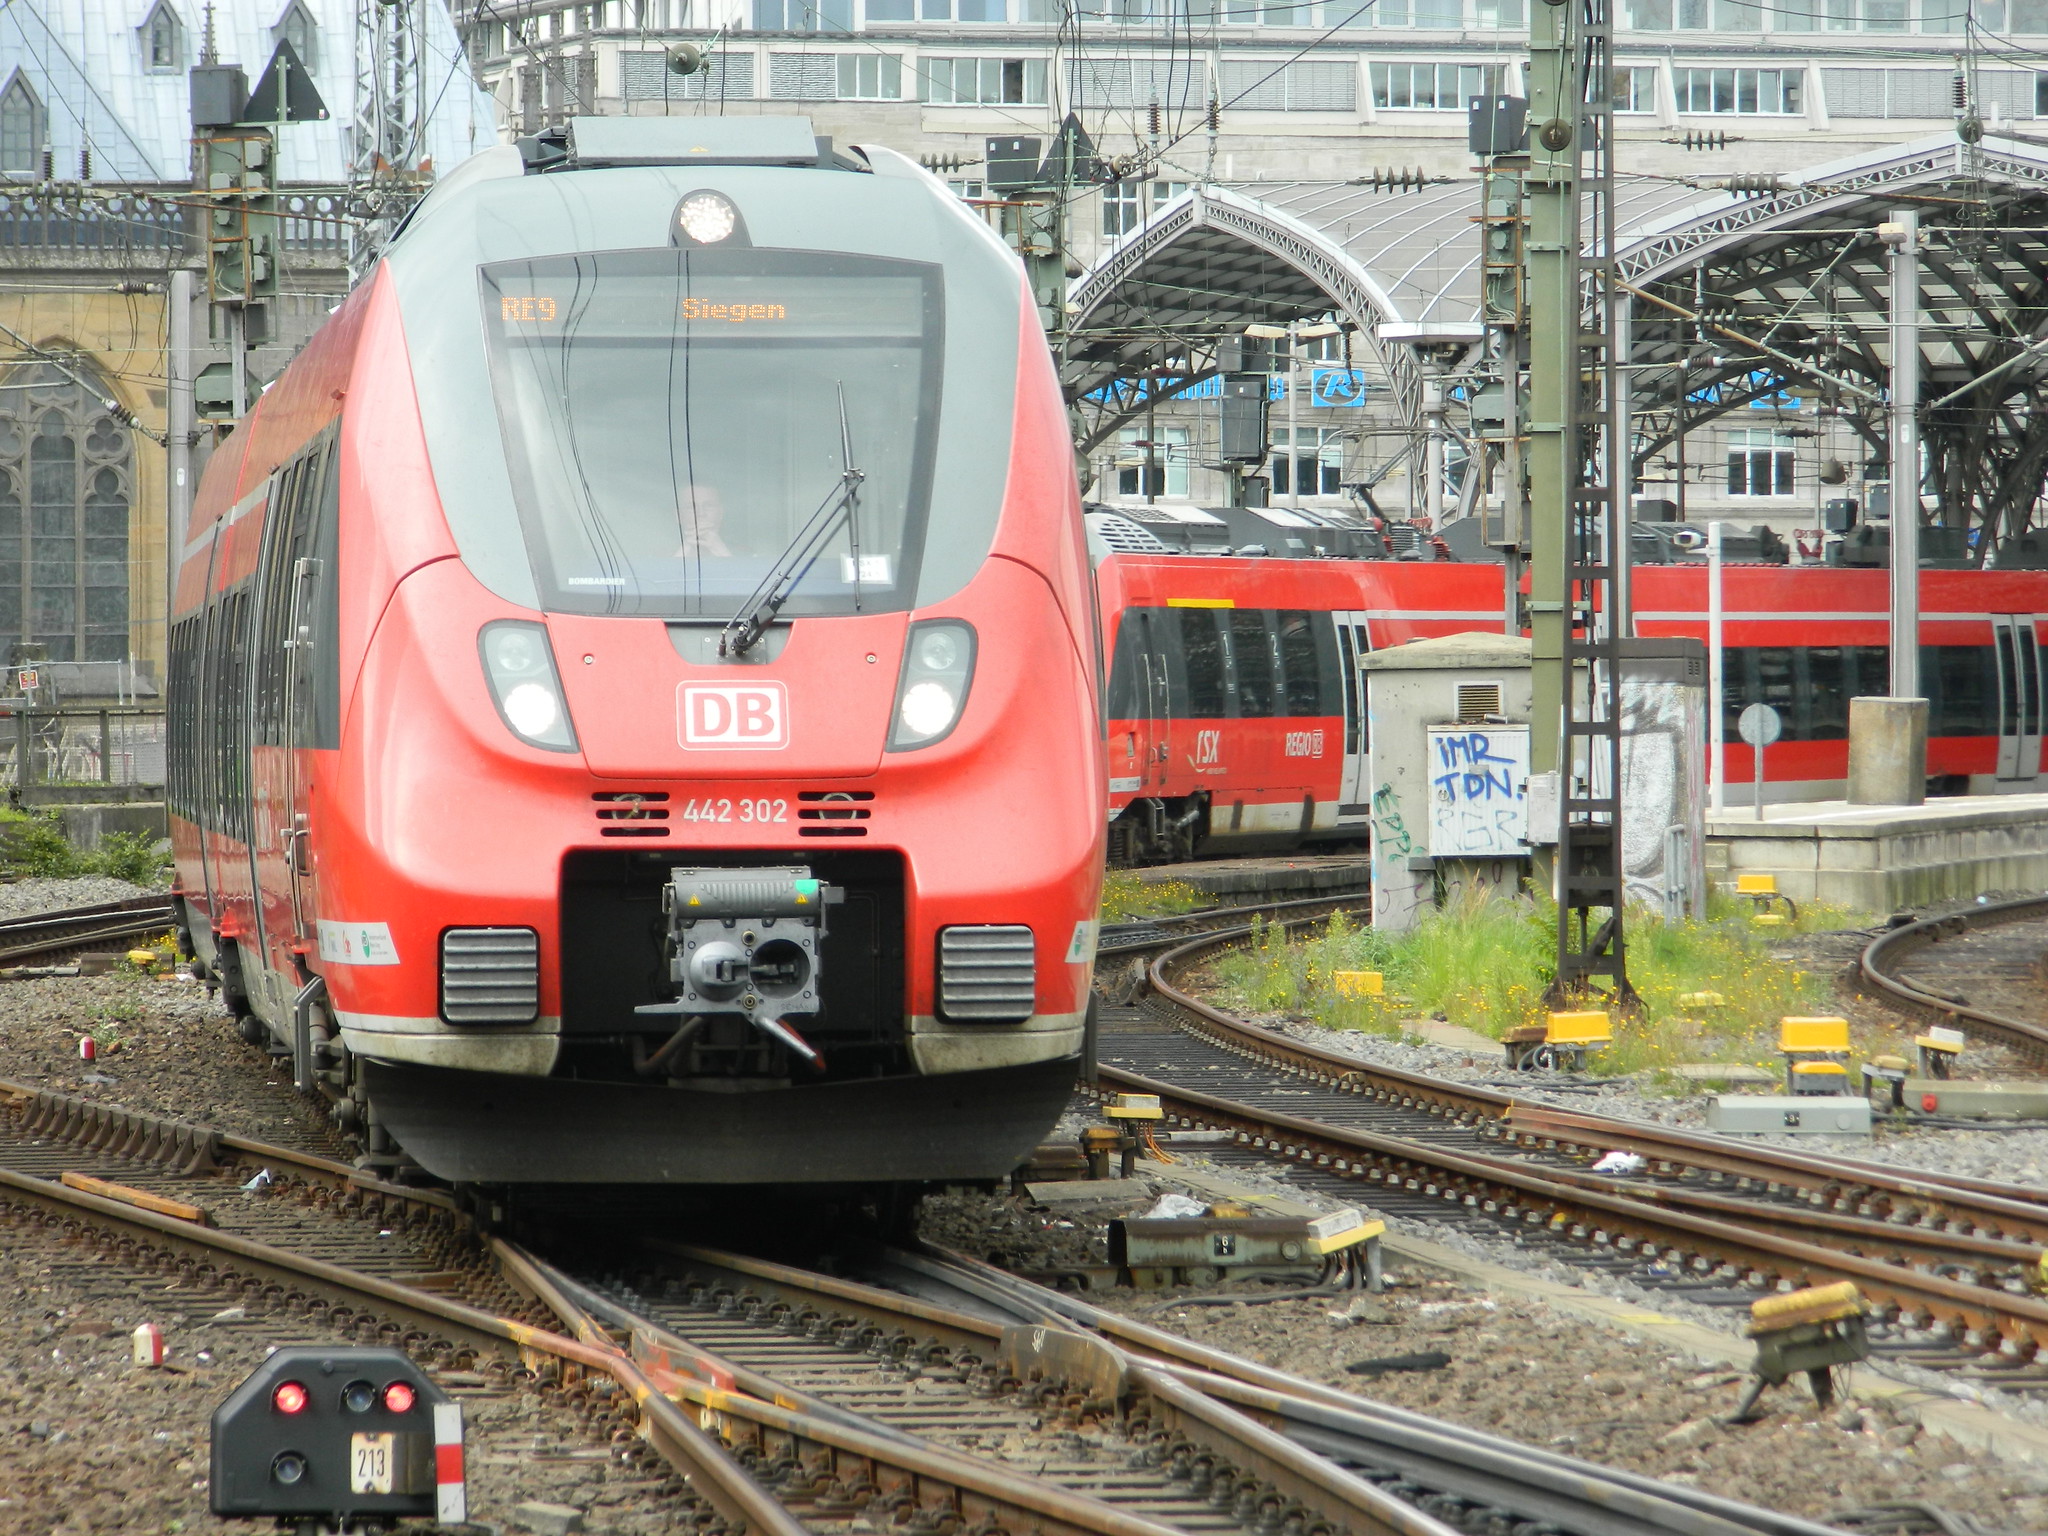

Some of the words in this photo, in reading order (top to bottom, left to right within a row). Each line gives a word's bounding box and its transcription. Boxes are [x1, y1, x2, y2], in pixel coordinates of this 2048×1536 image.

[501, 297, 557, 321] RE9
[682, 298, 786, 323] Siegen
[568, 577, 626, 586] BOMBARDIER
[688, 690, 777, 740] DB
[1285, 731, 1311, 757] REGIO
[683, 798, 732, 824] 442
[739, 798, 787, 824] 302
[1222, 1236, 1229, 1247] 6
[357, 1448, 386, 1478] 213
